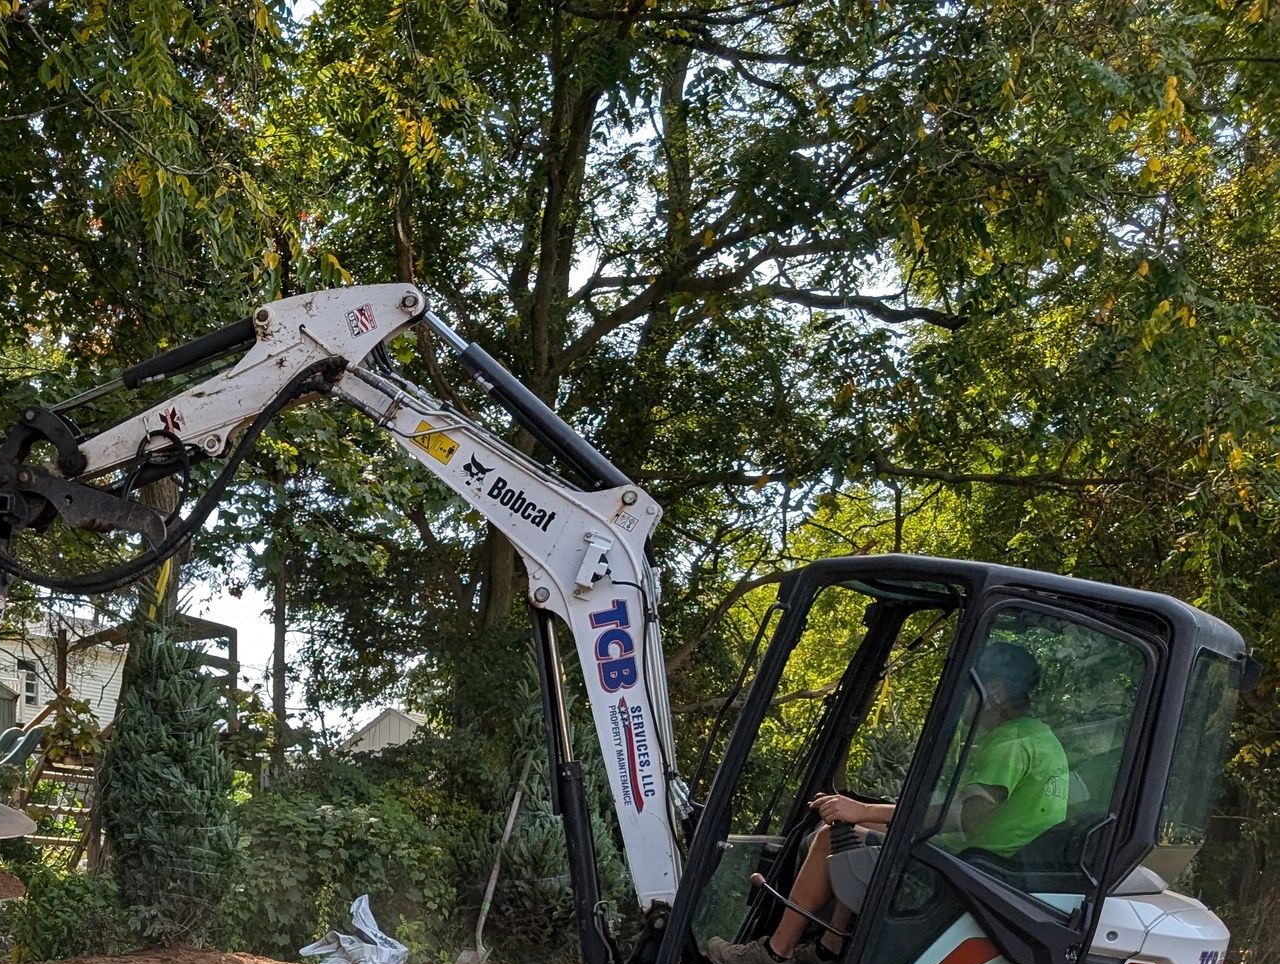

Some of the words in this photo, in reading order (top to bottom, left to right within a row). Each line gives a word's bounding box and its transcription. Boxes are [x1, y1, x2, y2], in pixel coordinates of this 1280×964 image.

[487, 476, 557, 532] Bobcat
[589, 599, 637, 693] TCB
[608, 704, 623, 747] PROPERTY
[630, 705, 651, 772] SERVICES,
[641, 774, 656, 797] LLC
[615, 749, 631, 806] MAINTENANCE
